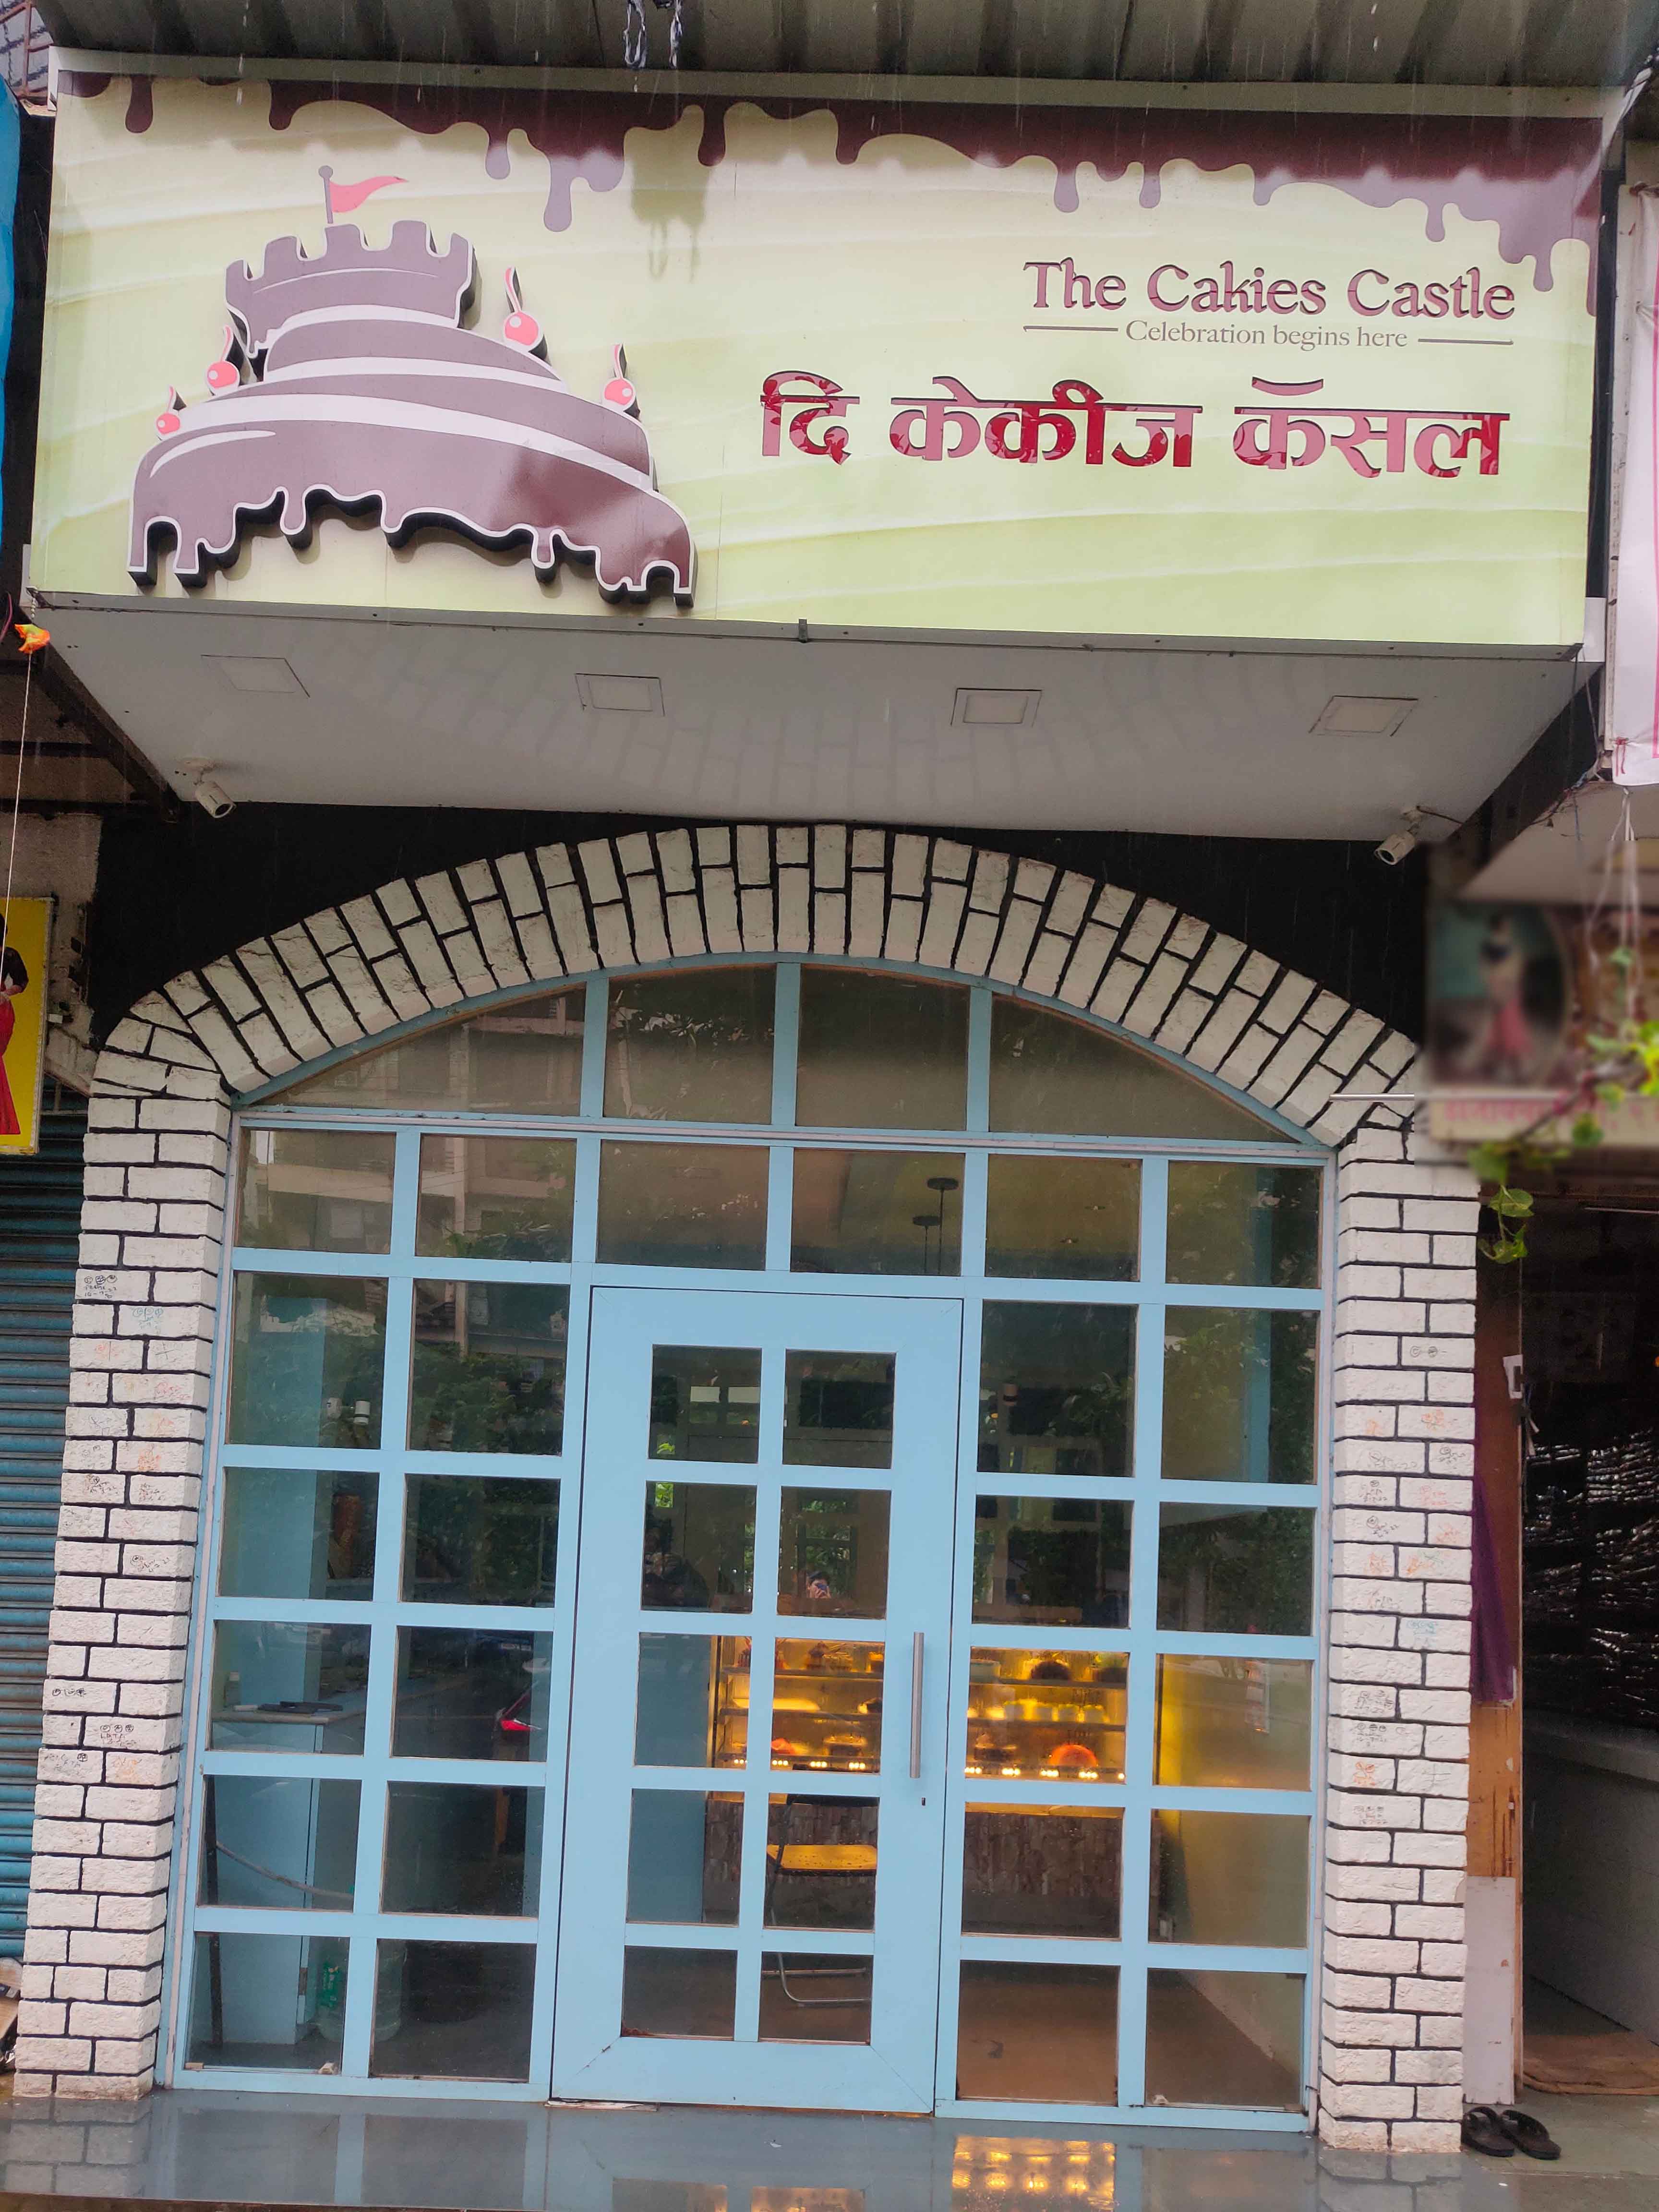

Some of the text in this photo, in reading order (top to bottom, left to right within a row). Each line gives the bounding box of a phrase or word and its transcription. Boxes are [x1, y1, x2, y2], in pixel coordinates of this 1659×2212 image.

[1023, 257, 1515, 320] The Cakies Castle
[1126, 319, 1408, 351] Celebration begins here
[760, 370, 1511, 478] दि केकीज कॅसल
